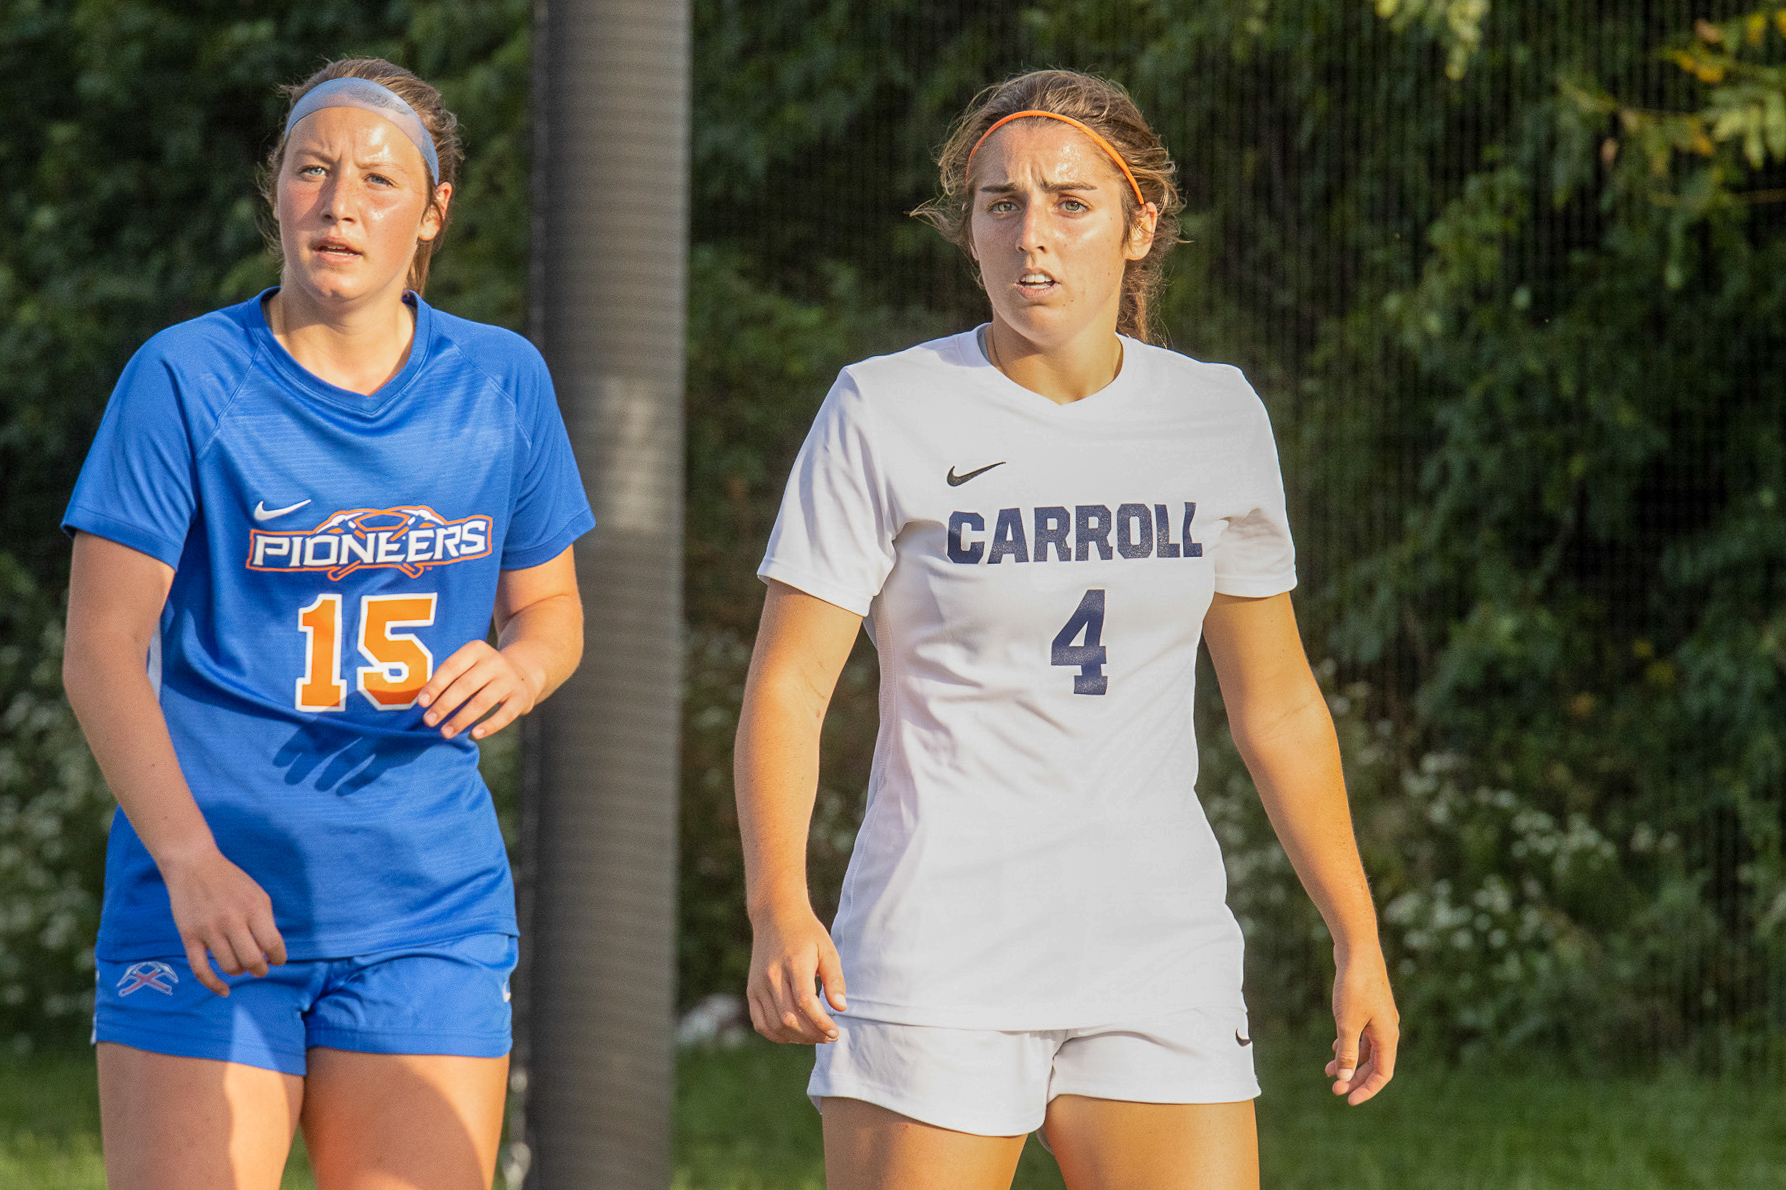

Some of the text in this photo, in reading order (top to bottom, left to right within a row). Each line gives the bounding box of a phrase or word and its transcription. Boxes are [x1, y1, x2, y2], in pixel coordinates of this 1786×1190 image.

[252, 520, 487, 567] PIONEERS
[947, 501, 1203, 565] CARROLL
[295, 592, 438, 712] 15
[1050, 588, 1108, 696] 4
